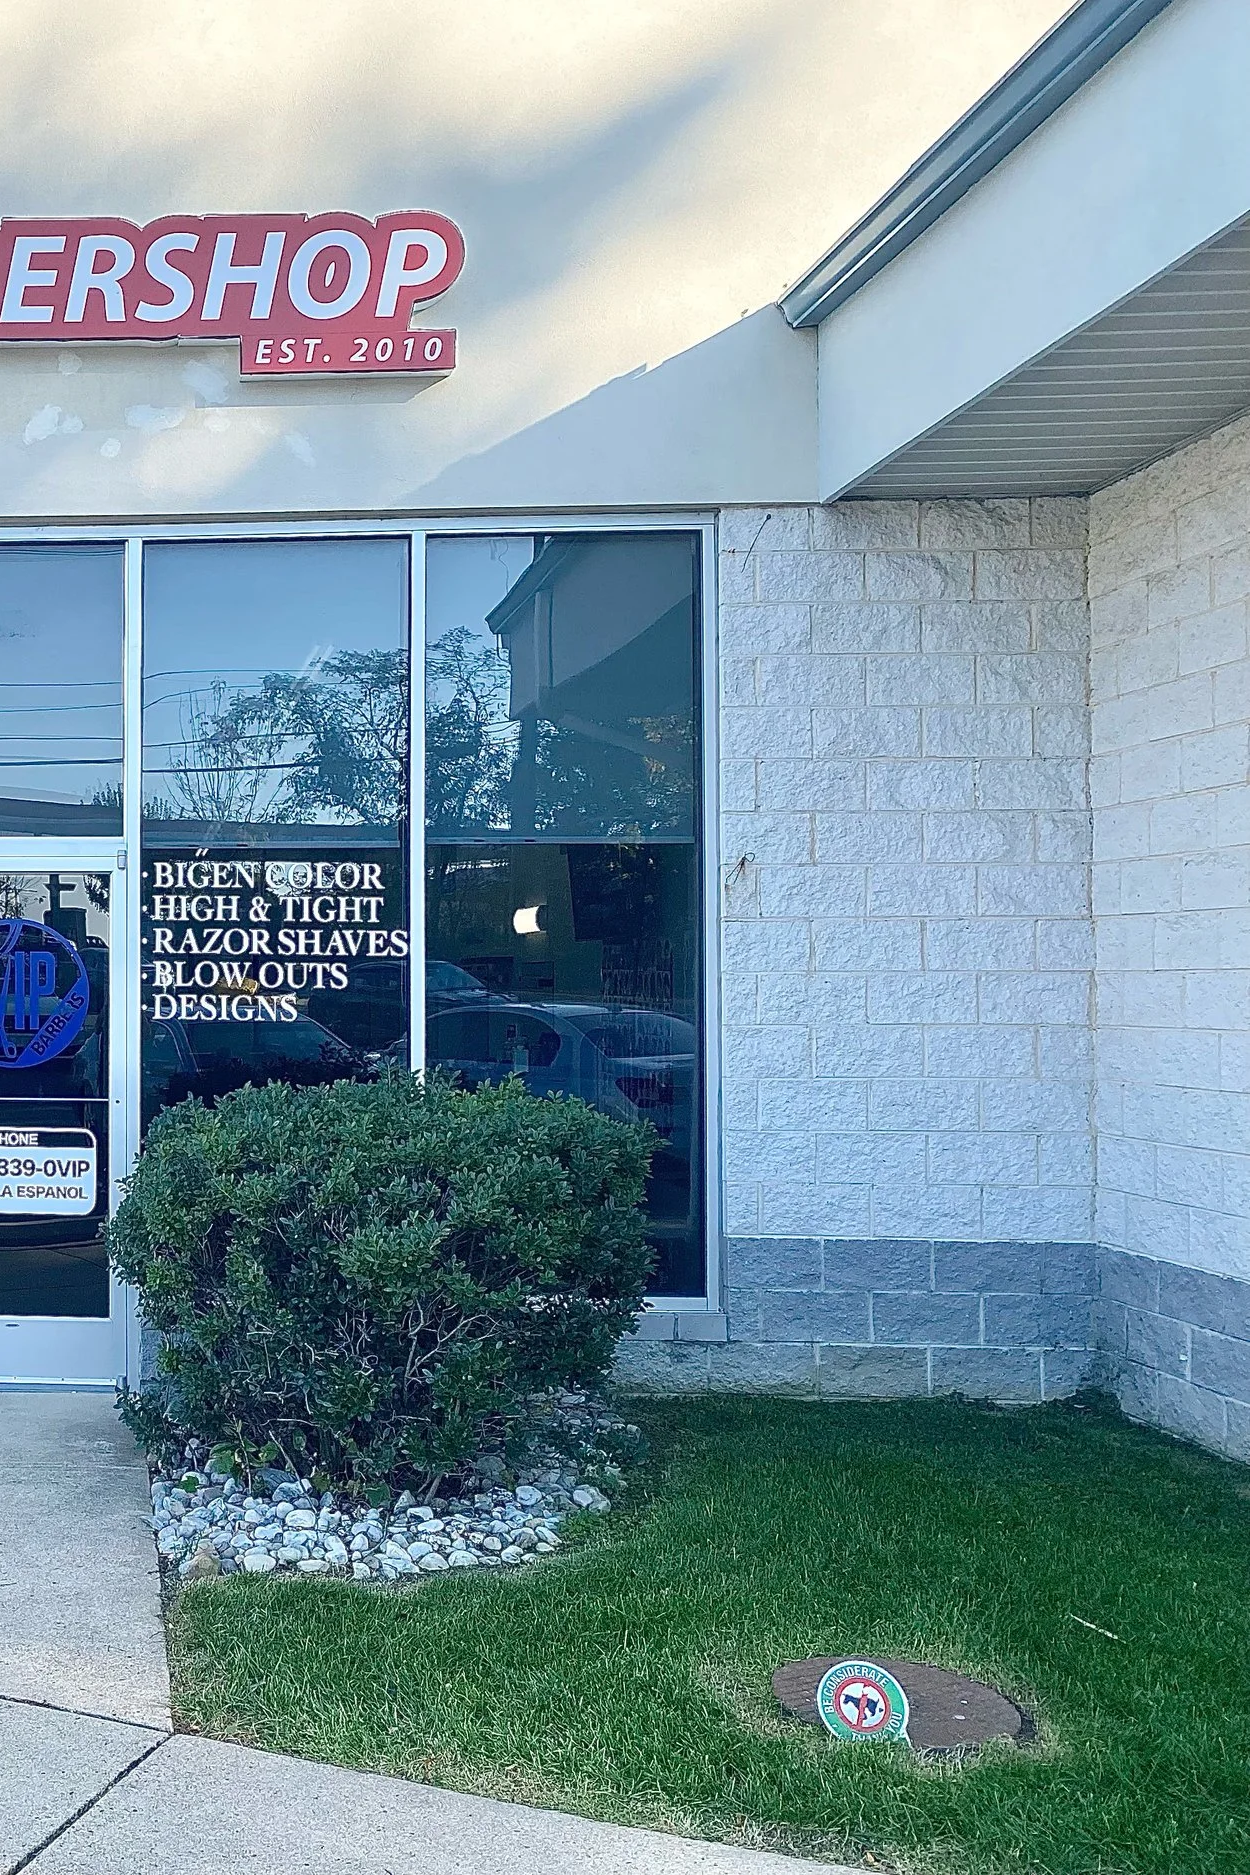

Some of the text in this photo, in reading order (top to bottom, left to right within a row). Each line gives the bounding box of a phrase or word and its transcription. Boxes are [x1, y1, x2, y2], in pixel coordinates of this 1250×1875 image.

[255, 337, 443, 364] EST. 2010
[152, 862, 386, 890] BIGEN COLOR
[151, 895, 385, 923] HIGH & TIGHT
[152, 928, 409, 957] RAZOR SHAVES
[152, 960, 349, 989] BLOW OUTS
[152, 993, 298, 1022] DESIGNS
[823, 1665, 890, 1698] CONSIDERATE
[885, 1711, 904, 1735] YOU
